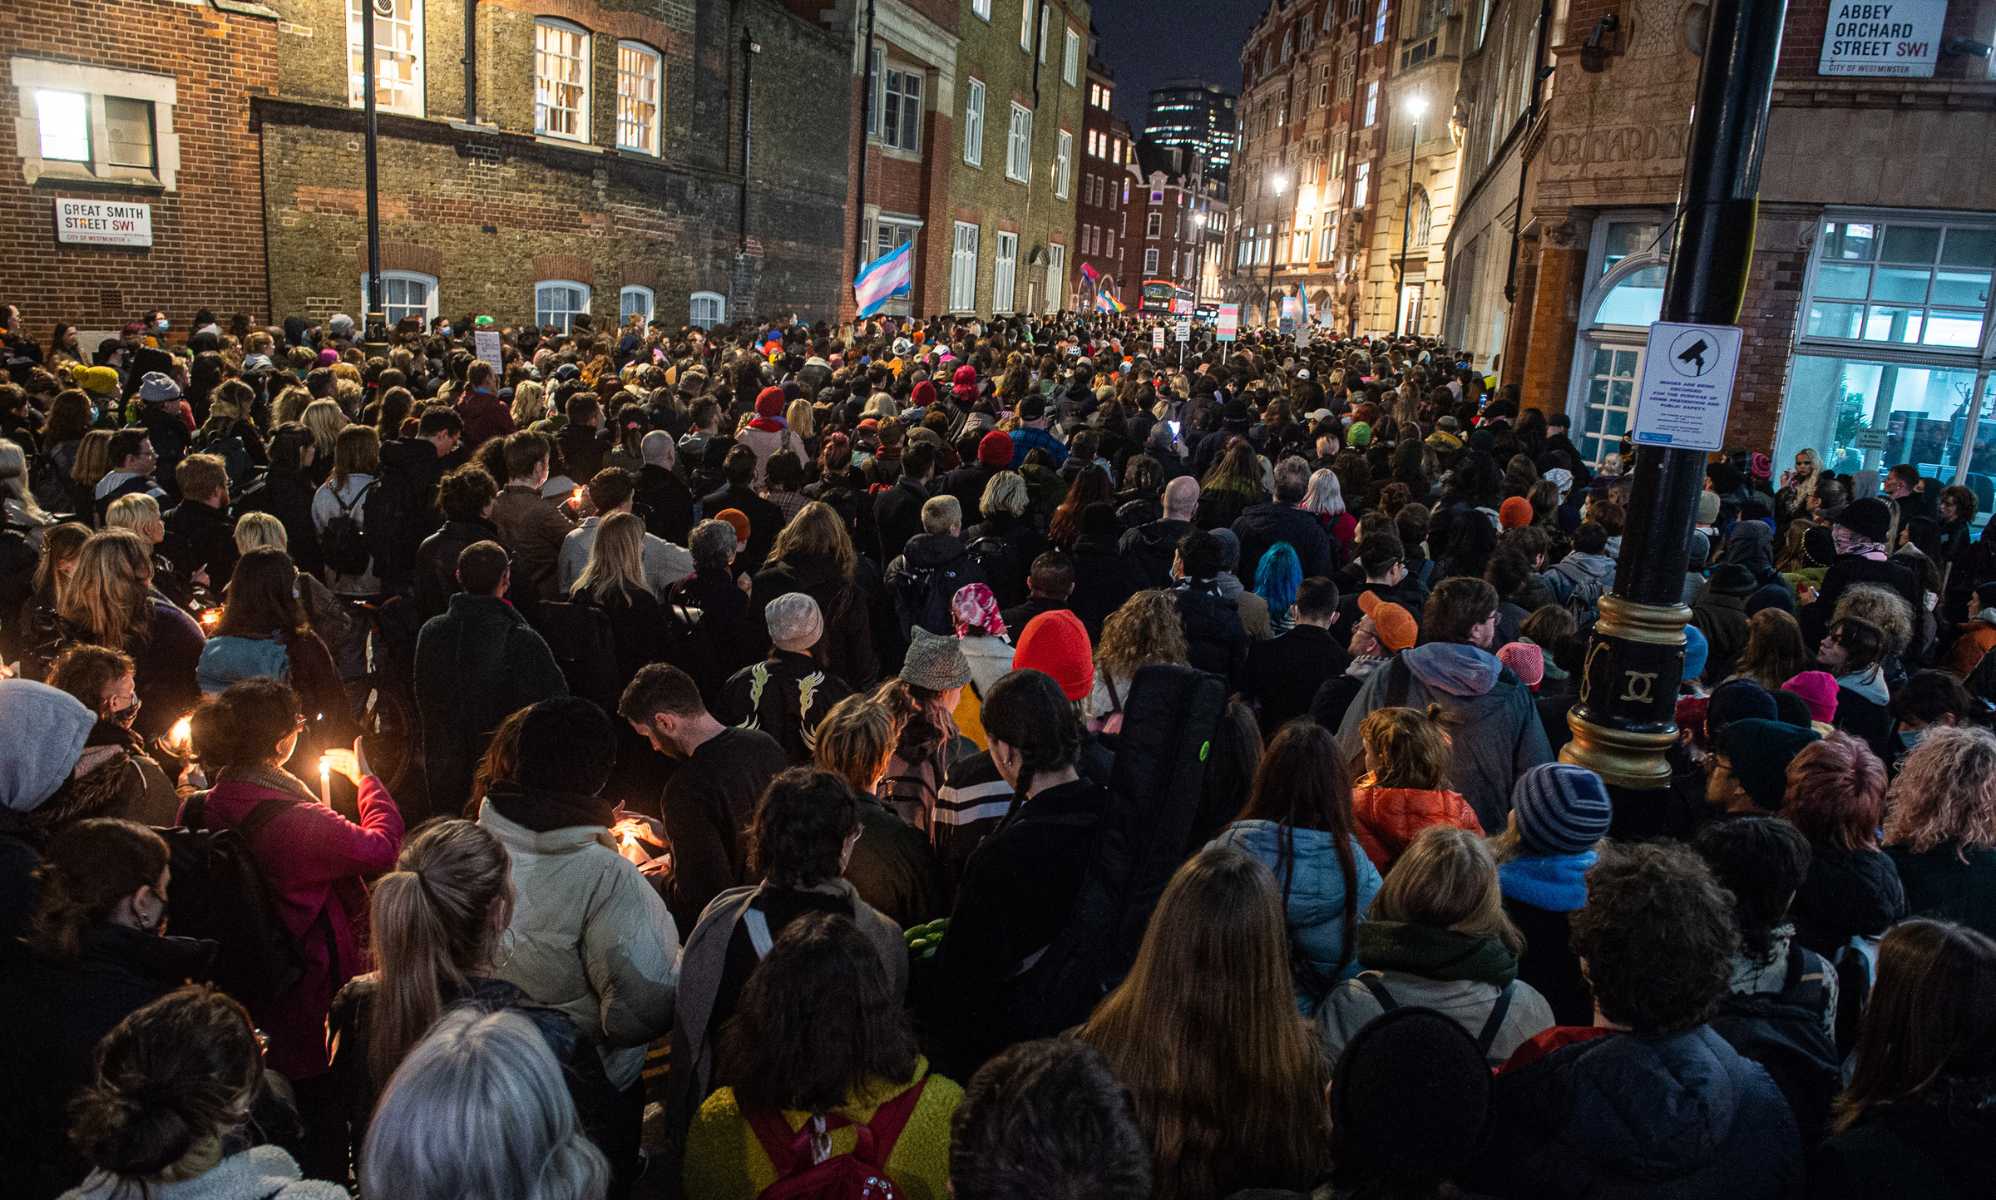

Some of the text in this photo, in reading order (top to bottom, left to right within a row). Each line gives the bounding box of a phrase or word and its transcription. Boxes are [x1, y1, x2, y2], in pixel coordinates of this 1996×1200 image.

[1840, 4, 1893, 19] ABBEY
[1836, 22, 1913, 38] ORCHARD
[1832, 41, 1928, 57] STREET SW1
[1829, 63, 1910, 73] CITY OF WESTMINSTER
[64, 203, 143, 219] GREAT SMITH
[65, 217, 134, 231] STREET SW1
